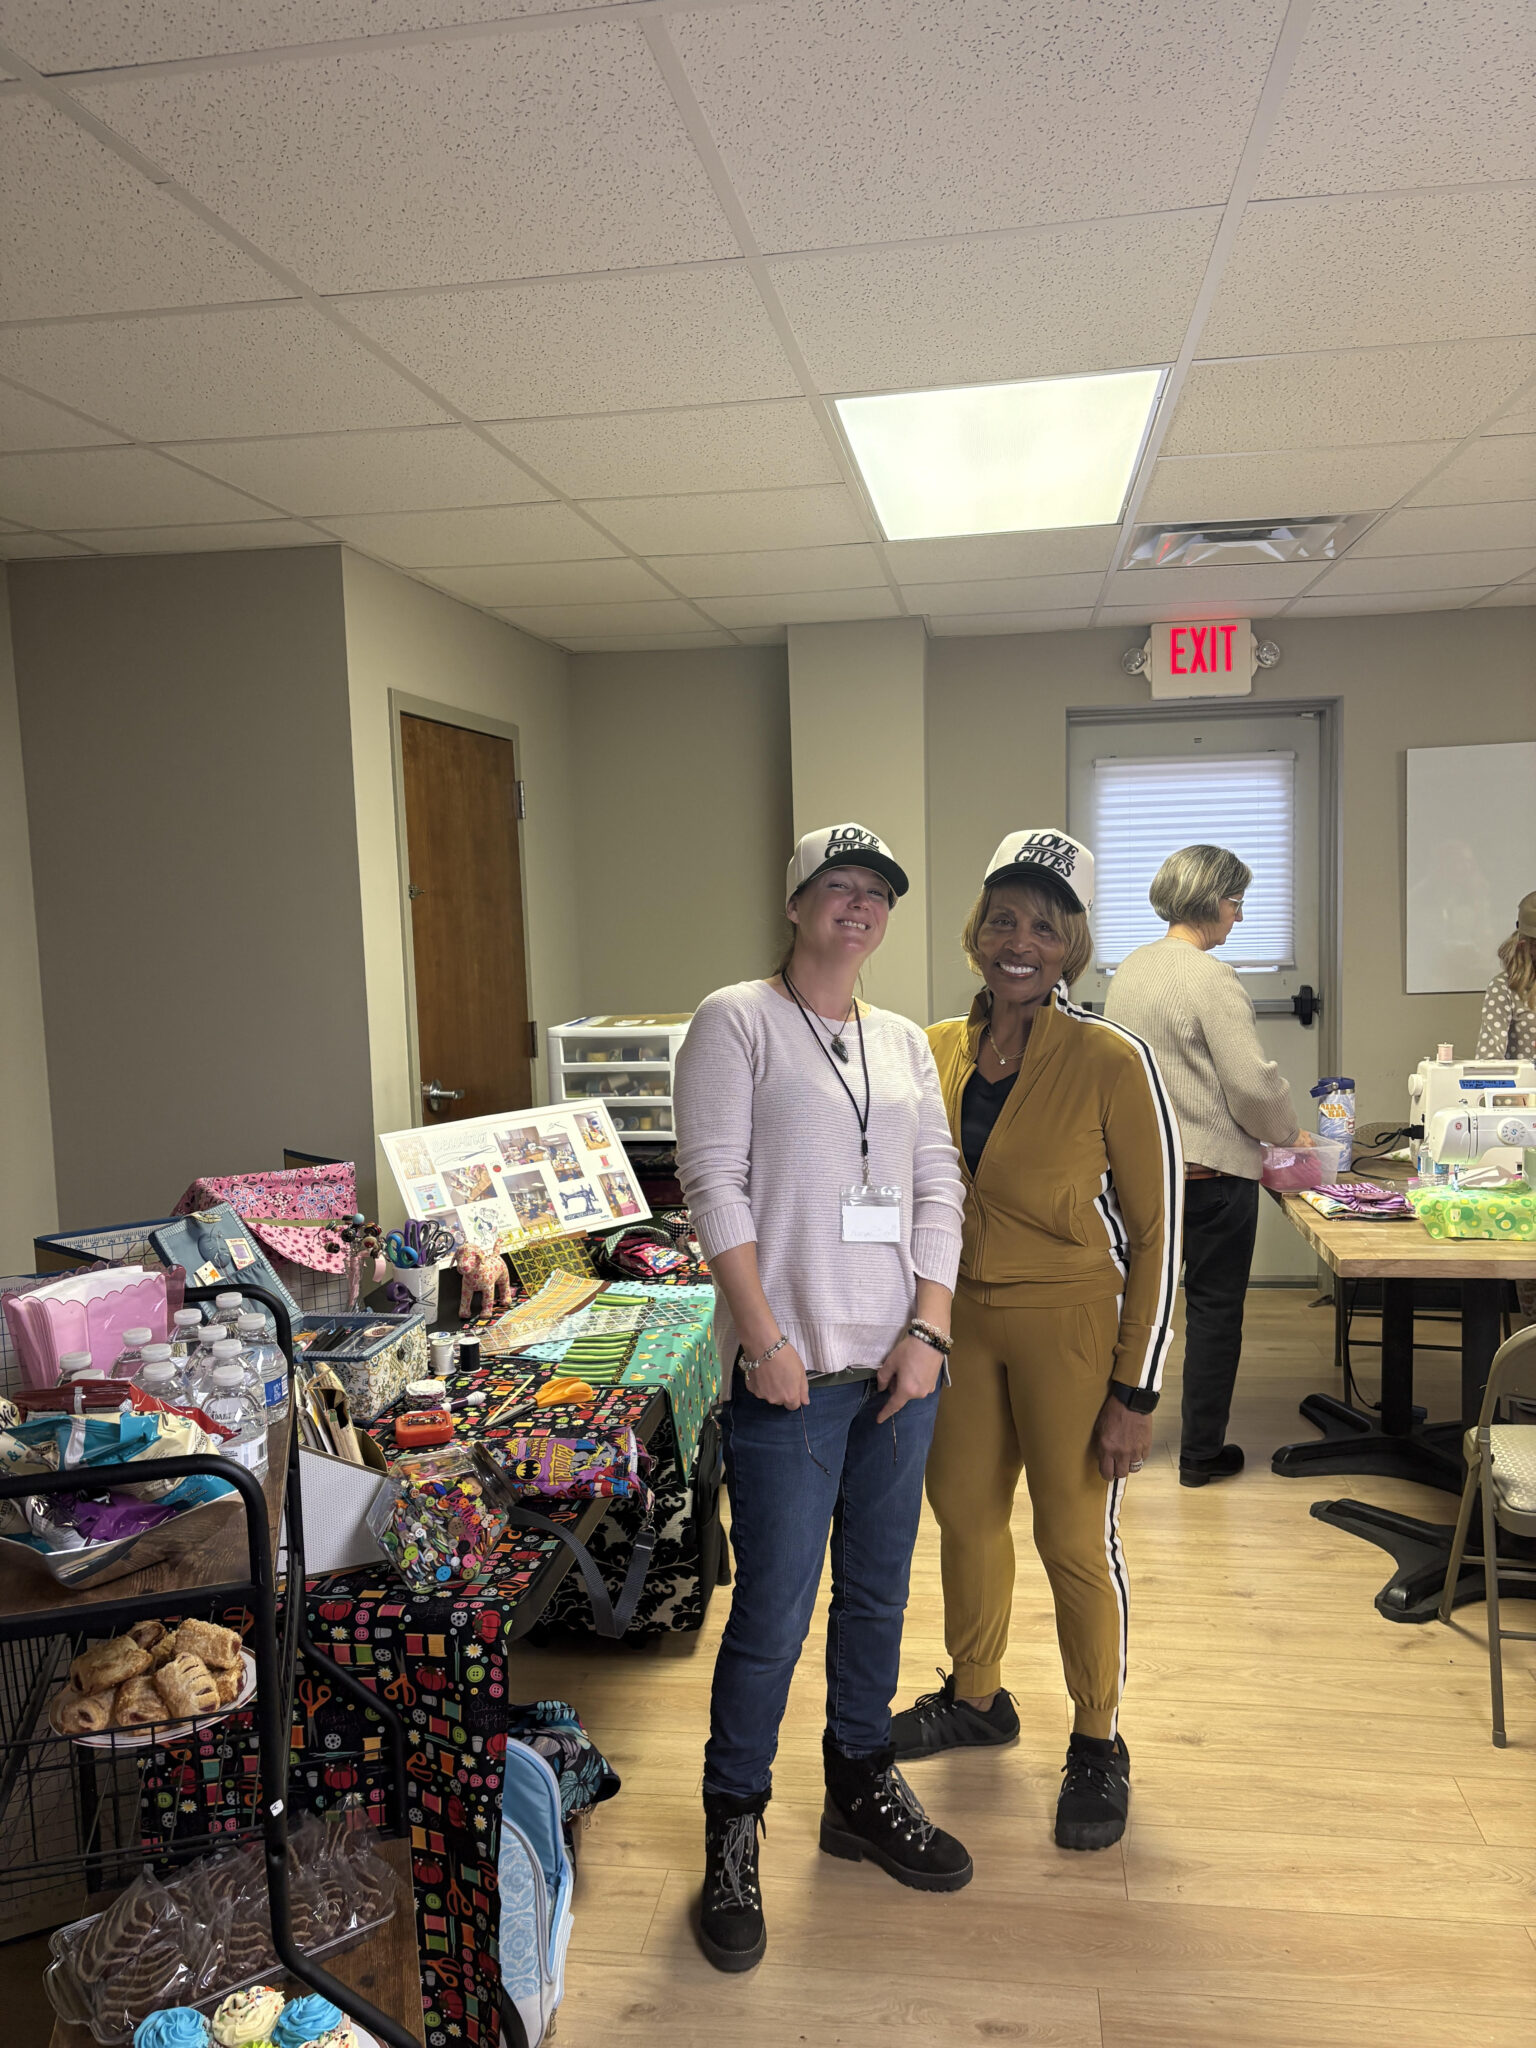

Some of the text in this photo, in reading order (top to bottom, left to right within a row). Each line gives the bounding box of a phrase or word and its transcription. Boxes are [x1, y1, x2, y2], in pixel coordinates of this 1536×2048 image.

[1170, 624, 1237, 675] EXIT
[828, 827, 880, 849] LOVE
[1024, 833, 1079, 860] LOVE
[1014, 848, 1076, 877] GIVES
[554, 1443, 577, 1485] BATGIRL
